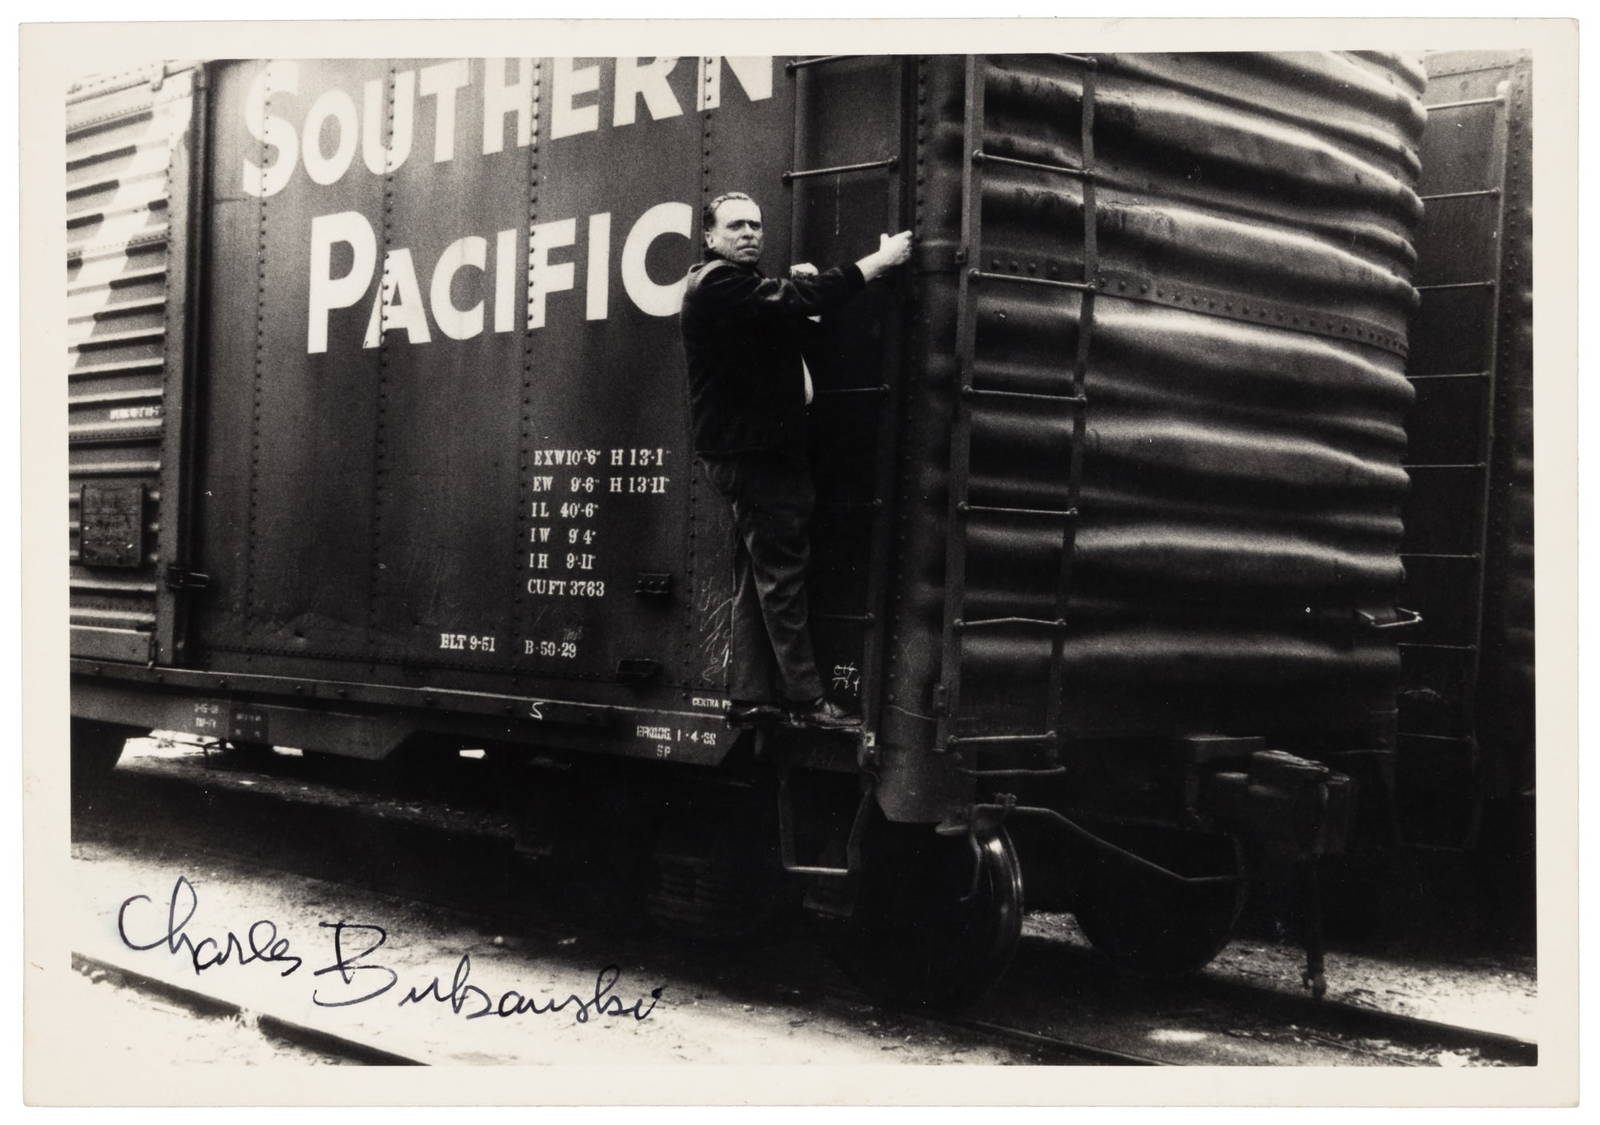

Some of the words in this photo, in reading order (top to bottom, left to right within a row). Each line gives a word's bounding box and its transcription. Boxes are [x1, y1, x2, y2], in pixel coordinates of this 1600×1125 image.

[243, 56, 773, 198] SOUTHERN
[307, 202, 693, 354] PACIFIC
[532, 476, 553, 492] EW
[569, 580, 605, 597] 3763
[118, 876, 302, 977] Charles
